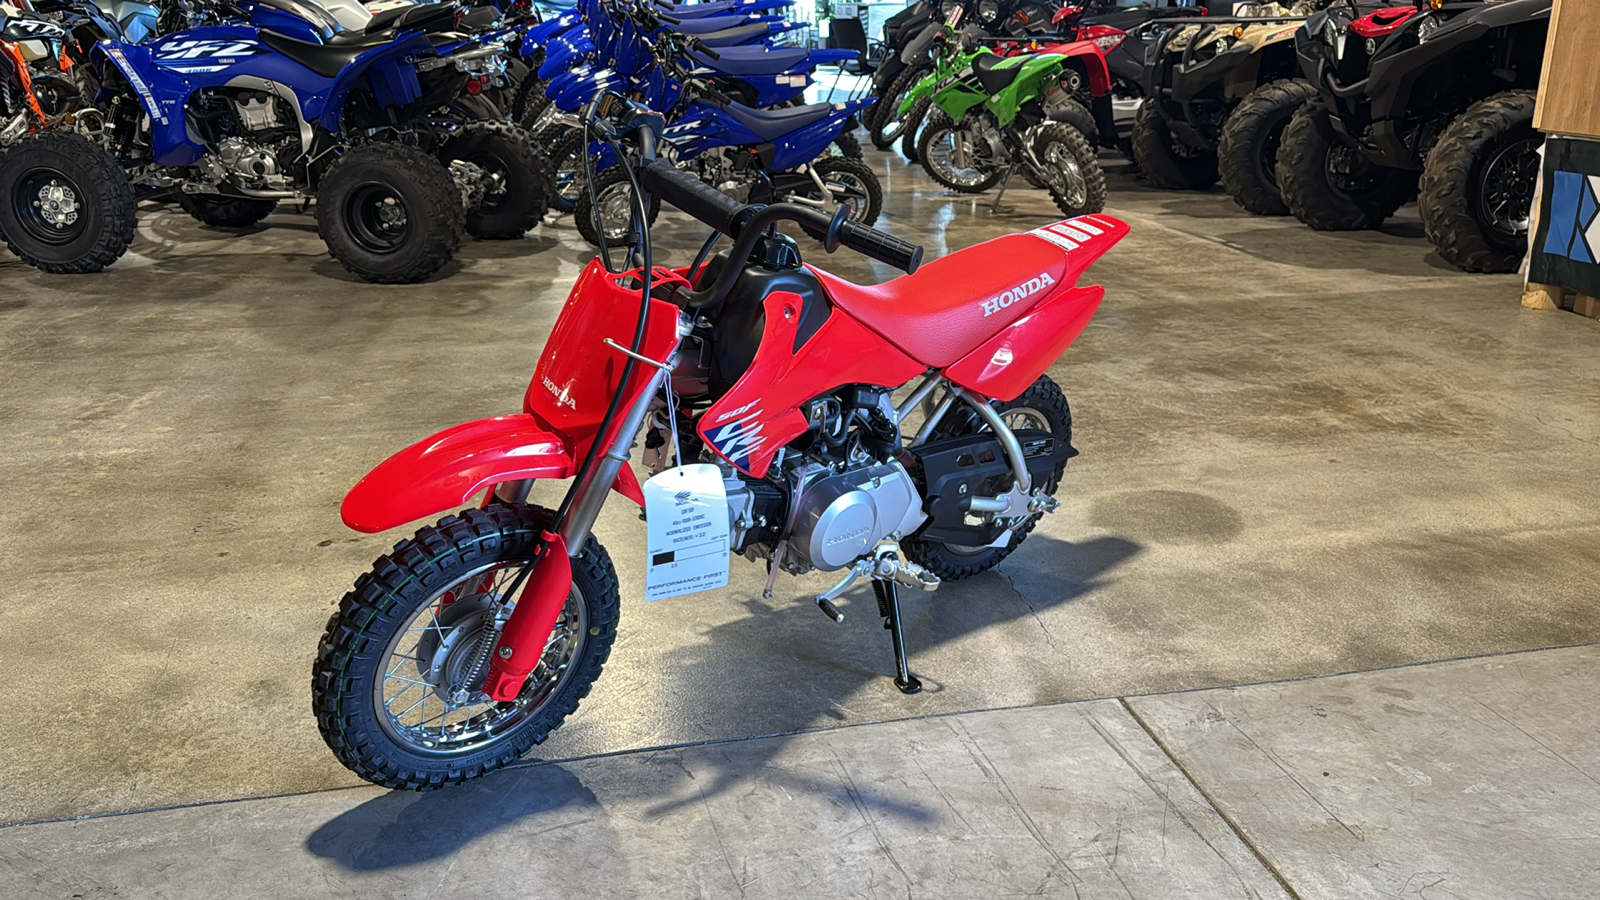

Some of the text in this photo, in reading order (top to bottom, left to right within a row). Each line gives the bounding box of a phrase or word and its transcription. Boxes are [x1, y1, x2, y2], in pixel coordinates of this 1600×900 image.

[156, 40, 259, 59] YFZ
[980, 272, 1056, 318] HONDA
[542, 376, 577, 411] HONDA
[647, 576, 702, 591] PERFORMANCE
